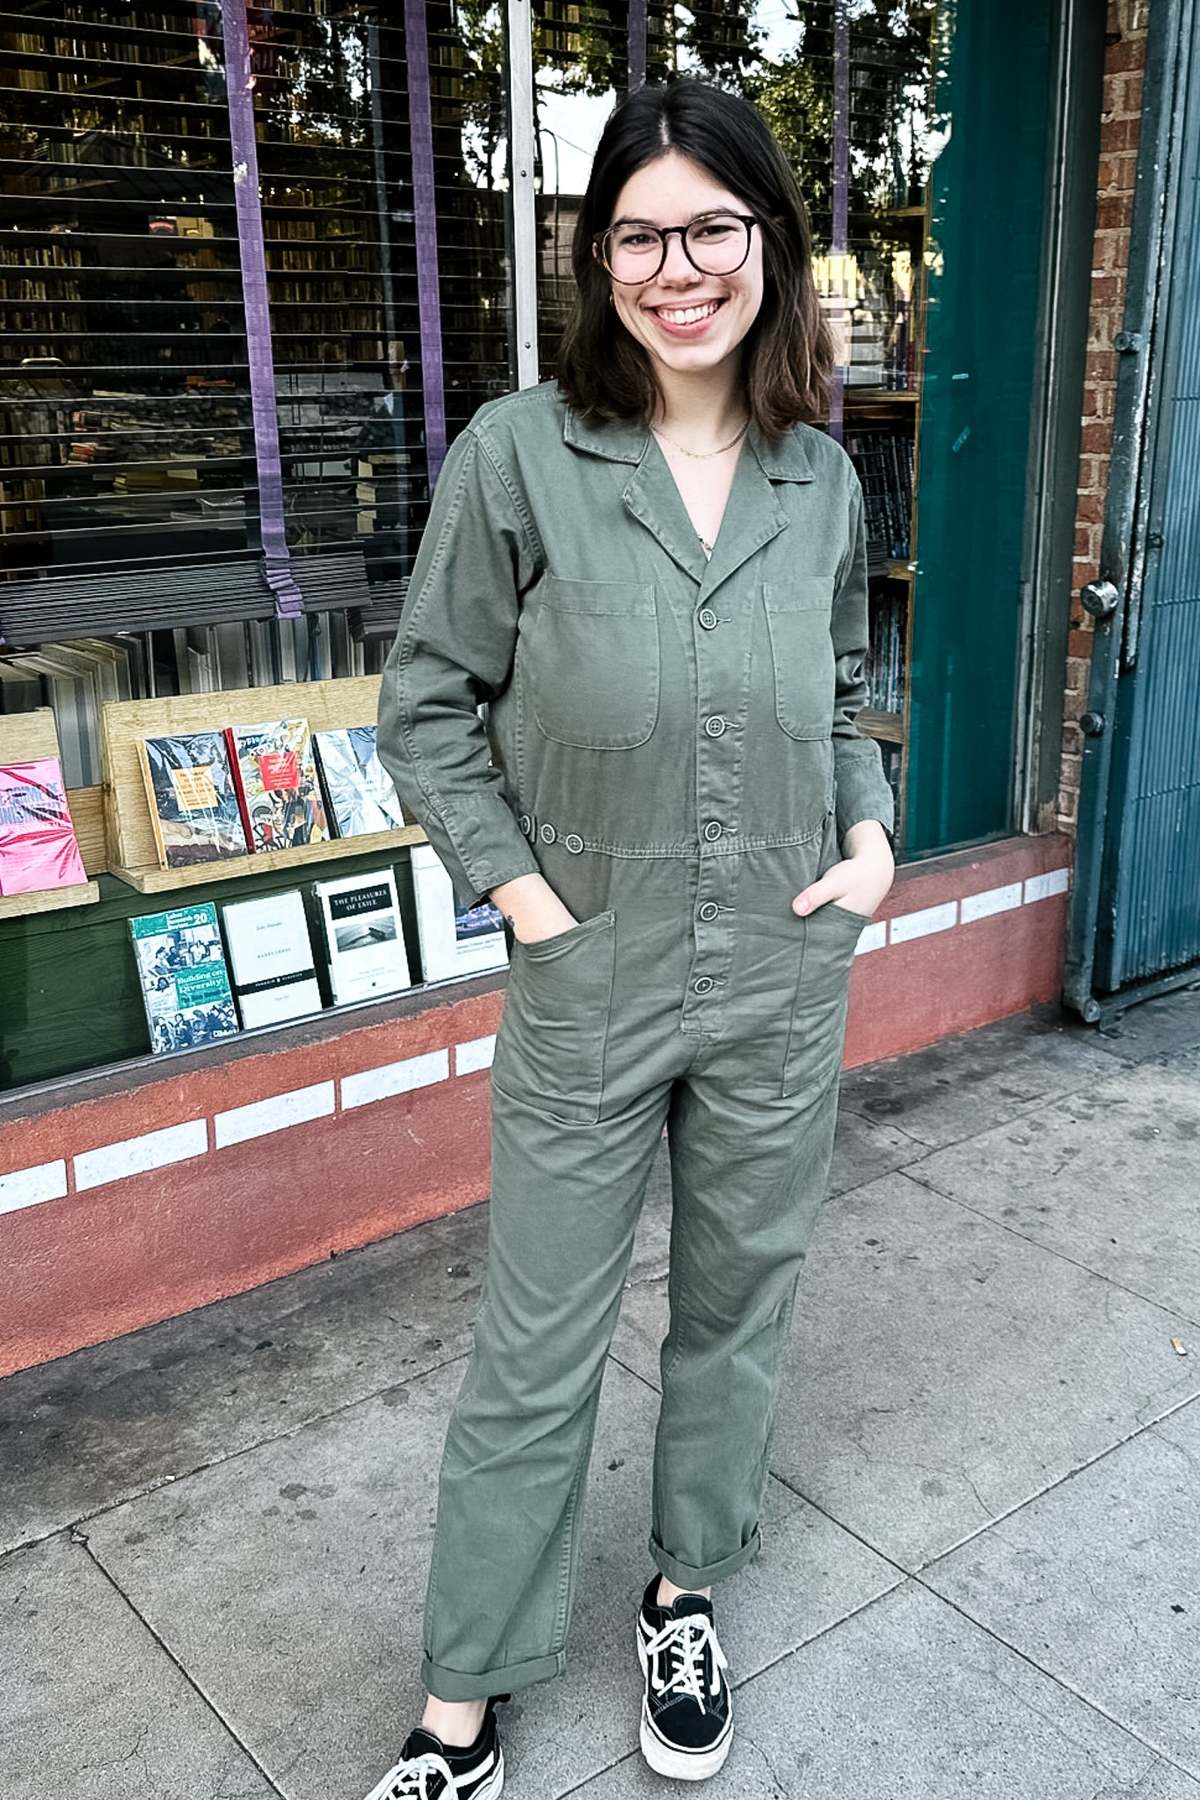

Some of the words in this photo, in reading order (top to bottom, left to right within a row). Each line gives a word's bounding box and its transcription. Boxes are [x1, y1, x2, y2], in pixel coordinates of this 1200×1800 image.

[334, 898, 348, 906] THE
[350, 889, 387, 902] PLEASURES
[346, 903, 355, 911] OF
[357, 899, 377, 909] EXILE
[193, 912, 208, 926] 20
